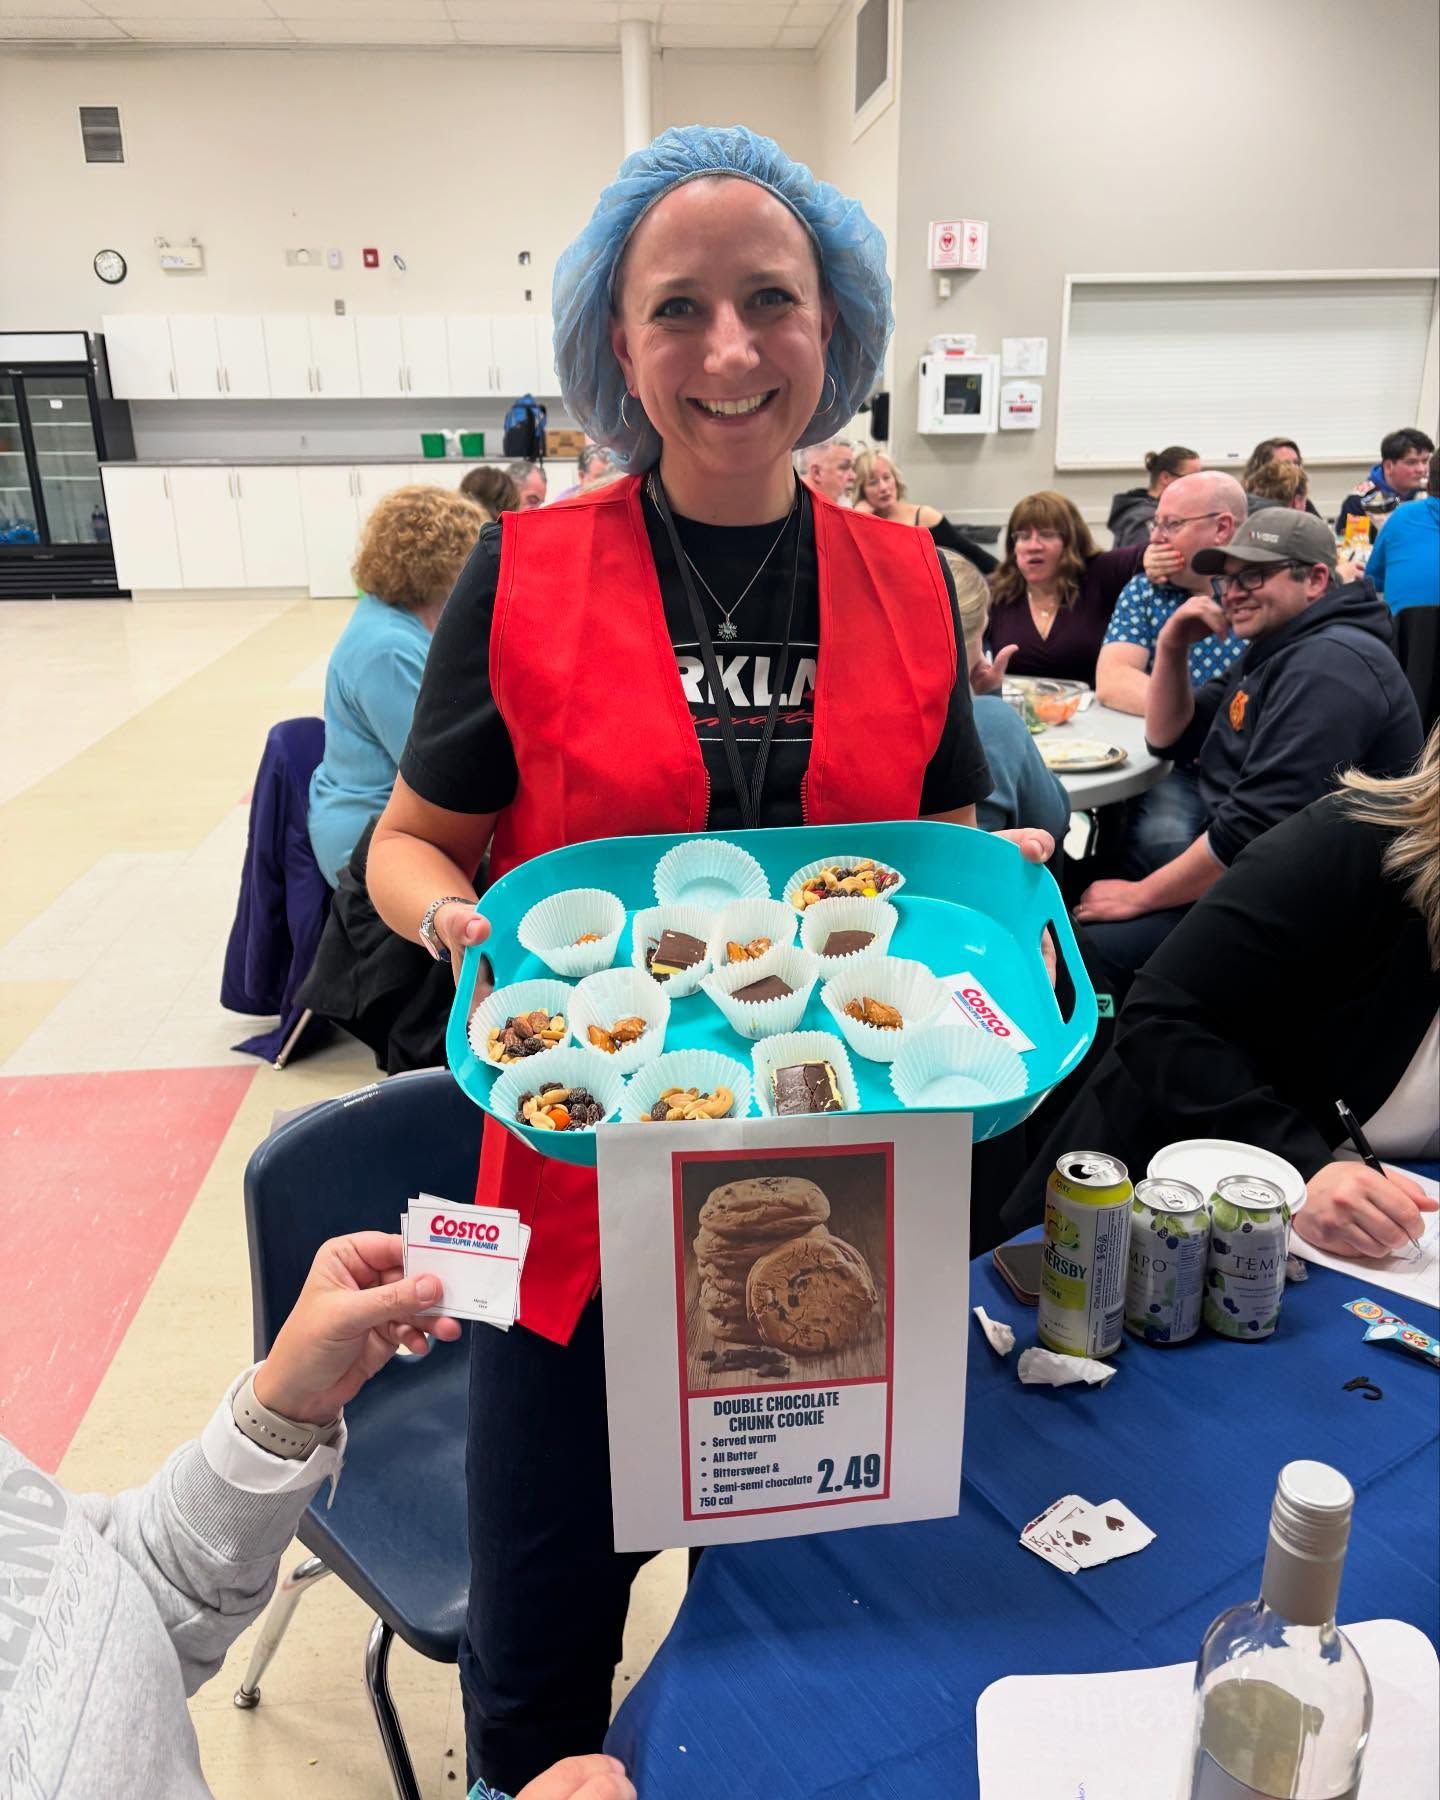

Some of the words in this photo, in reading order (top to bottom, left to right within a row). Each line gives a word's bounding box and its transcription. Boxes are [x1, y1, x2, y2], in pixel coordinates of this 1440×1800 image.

[962, 989, 1011, 1037] COSTCO
[430, 1215, 500, 1242] COSTCO
[452, 1238, 471, 1247] SUPER
[472, 1242, 499, 1251] MEMBER
[714, 1397, 763, 1416] DOUBLE
[767, 1392, 840, 1412] CHOCOLATE
[729, 1414, 774, 1432] CHUNK
[777, 1410, 824, 1428] COOKIE
[712, 1435, 747, 1448] Served
[749, 1434, 777, 1444] warm
[712, 1452, 724, 1463] All
[727, 1451, 758, 1462] Butter
[713, 1464, 771, 1478] Bittersweet
[772, 1463, 780, 1473] &
[817, 1454, 881, 1494] 2.49
[713, 1480, 763, 1493] Semi-semi
[765, 1475, 813, 1489] chocolate
[699, 1497, 716, 1507] 750
[718, 1495, 733, 1505] cal
[1029, 1536, 1045, 1548] K
[1056, 1530, 1066, 1540] 4
